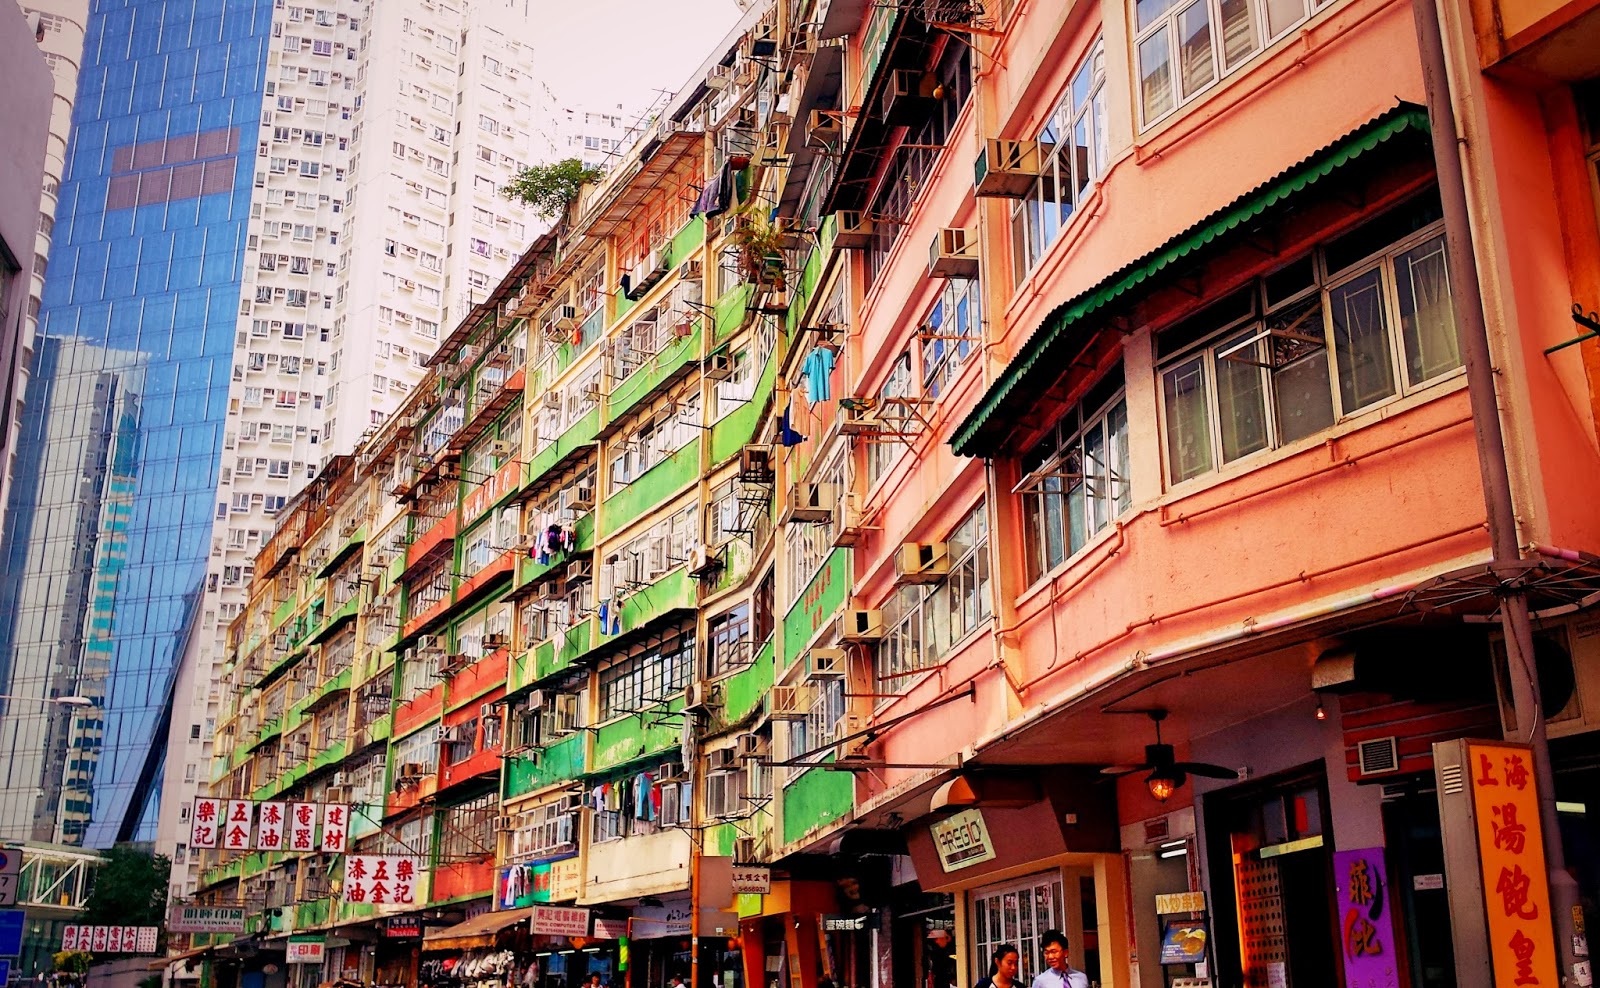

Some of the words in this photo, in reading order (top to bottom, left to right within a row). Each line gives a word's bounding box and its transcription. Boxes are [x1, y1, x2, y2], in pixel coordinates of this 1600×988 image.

[1477, 753, 1530, 790] 上海
[194, 801, 215, 845] 樂記
[227, 803, 248, 847] 五金
[260, 805, 282, 848] 漆油
[294, 806, 313, 849] 電器
[325, 807, 344, 850] 建材
[346, 858, 367, 903] 漆油
[369, 861, 390, 904] 五金
[393, 860, 414, 904] 樂記
